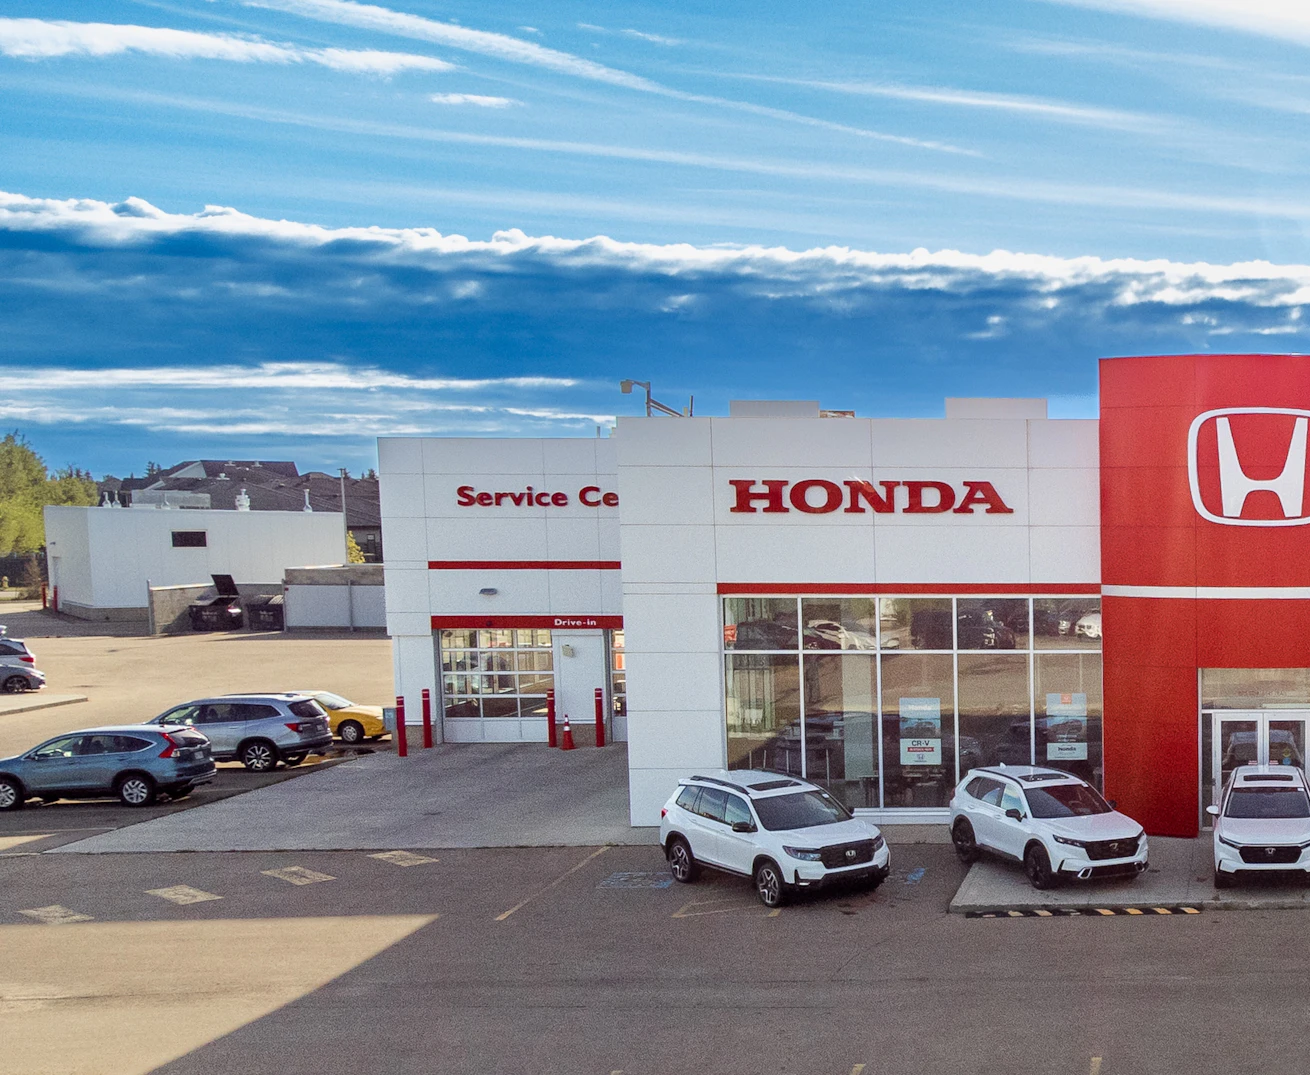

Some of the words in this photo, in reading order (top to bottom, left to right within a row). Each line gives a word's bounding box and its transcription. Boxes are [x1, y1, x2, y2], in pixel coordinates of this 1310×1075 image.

[456, 485, 568, 507] Service
[578, 485, 619, 507] Ce
[729, 479, 1014, 514] HONDA
[554, 618, 597, 626] Drive-in
